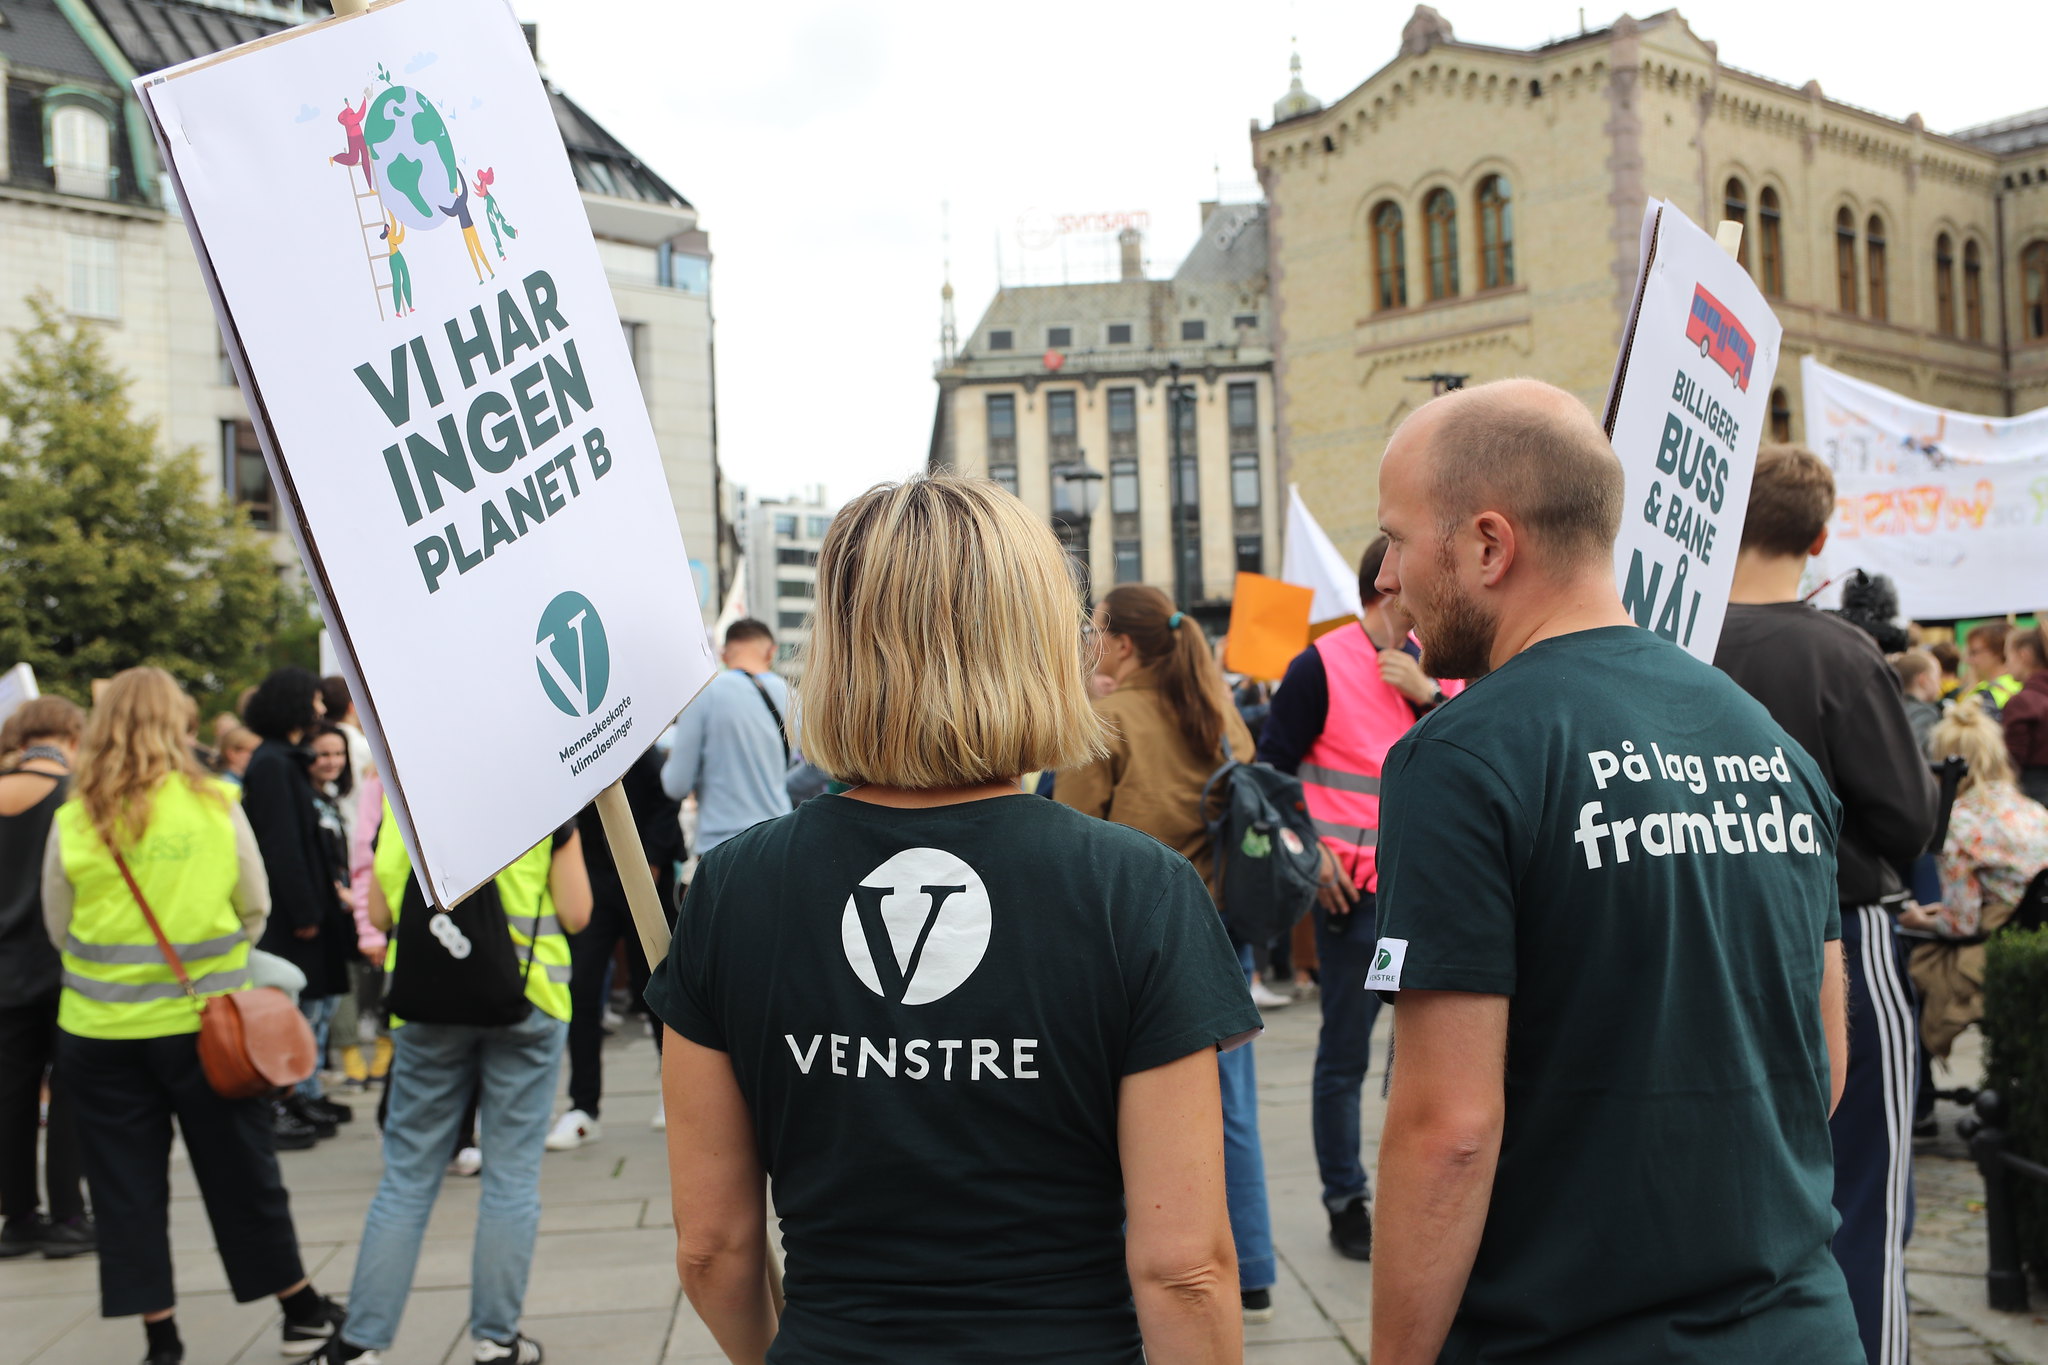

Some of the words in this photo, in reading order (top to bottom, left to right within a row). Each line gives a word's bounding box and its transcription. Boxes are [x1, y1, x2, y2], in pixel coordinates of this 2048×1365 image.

[353, 335, 445, 428] VI
[444, 270, 569, 389] HAR
[382, 338, 594, 527] INGEN
[1671, 369, 1740, 452] BILLIGERE
[1655, 411, 1729, 515] BUSS
[413, 444, 581, 594] PLANET
[582, 427, 612, 481] B
[1643, 480, 1662, 528] &
[1664, 494, 1717, 566] BANE
[558, 696, 632, 763] Menneskeskapte
[570, 716, 633, 777] klimaløsninger
[1650, 742, 1707, 795] lag
[1713, 746, 1792, 783] med
[1574, 793, 1821, 870] framtida.
[784, 1033, 1040, 1081] VENSTRE
